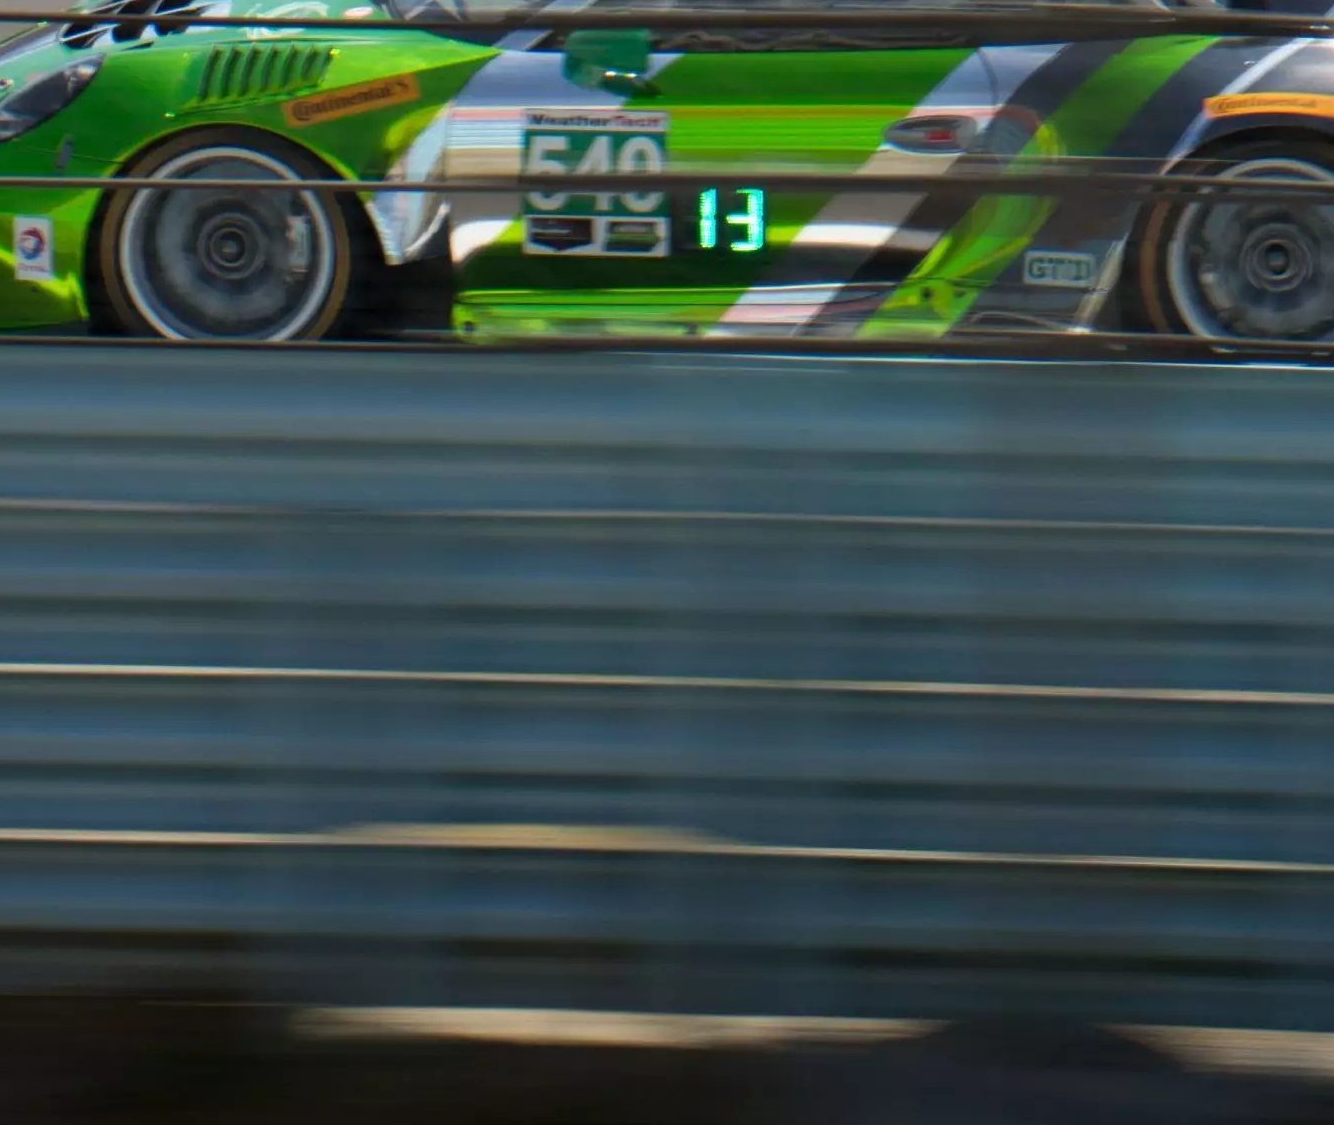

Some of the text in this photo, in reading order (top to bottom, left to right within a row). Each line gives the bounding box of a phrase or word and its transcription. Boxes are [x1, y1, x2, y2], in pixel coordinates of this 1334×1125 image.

[528, 113, 663, 127] WeatherTech
[528, 135, 664, 213] 540
[699, 188, 765, 252] 13
